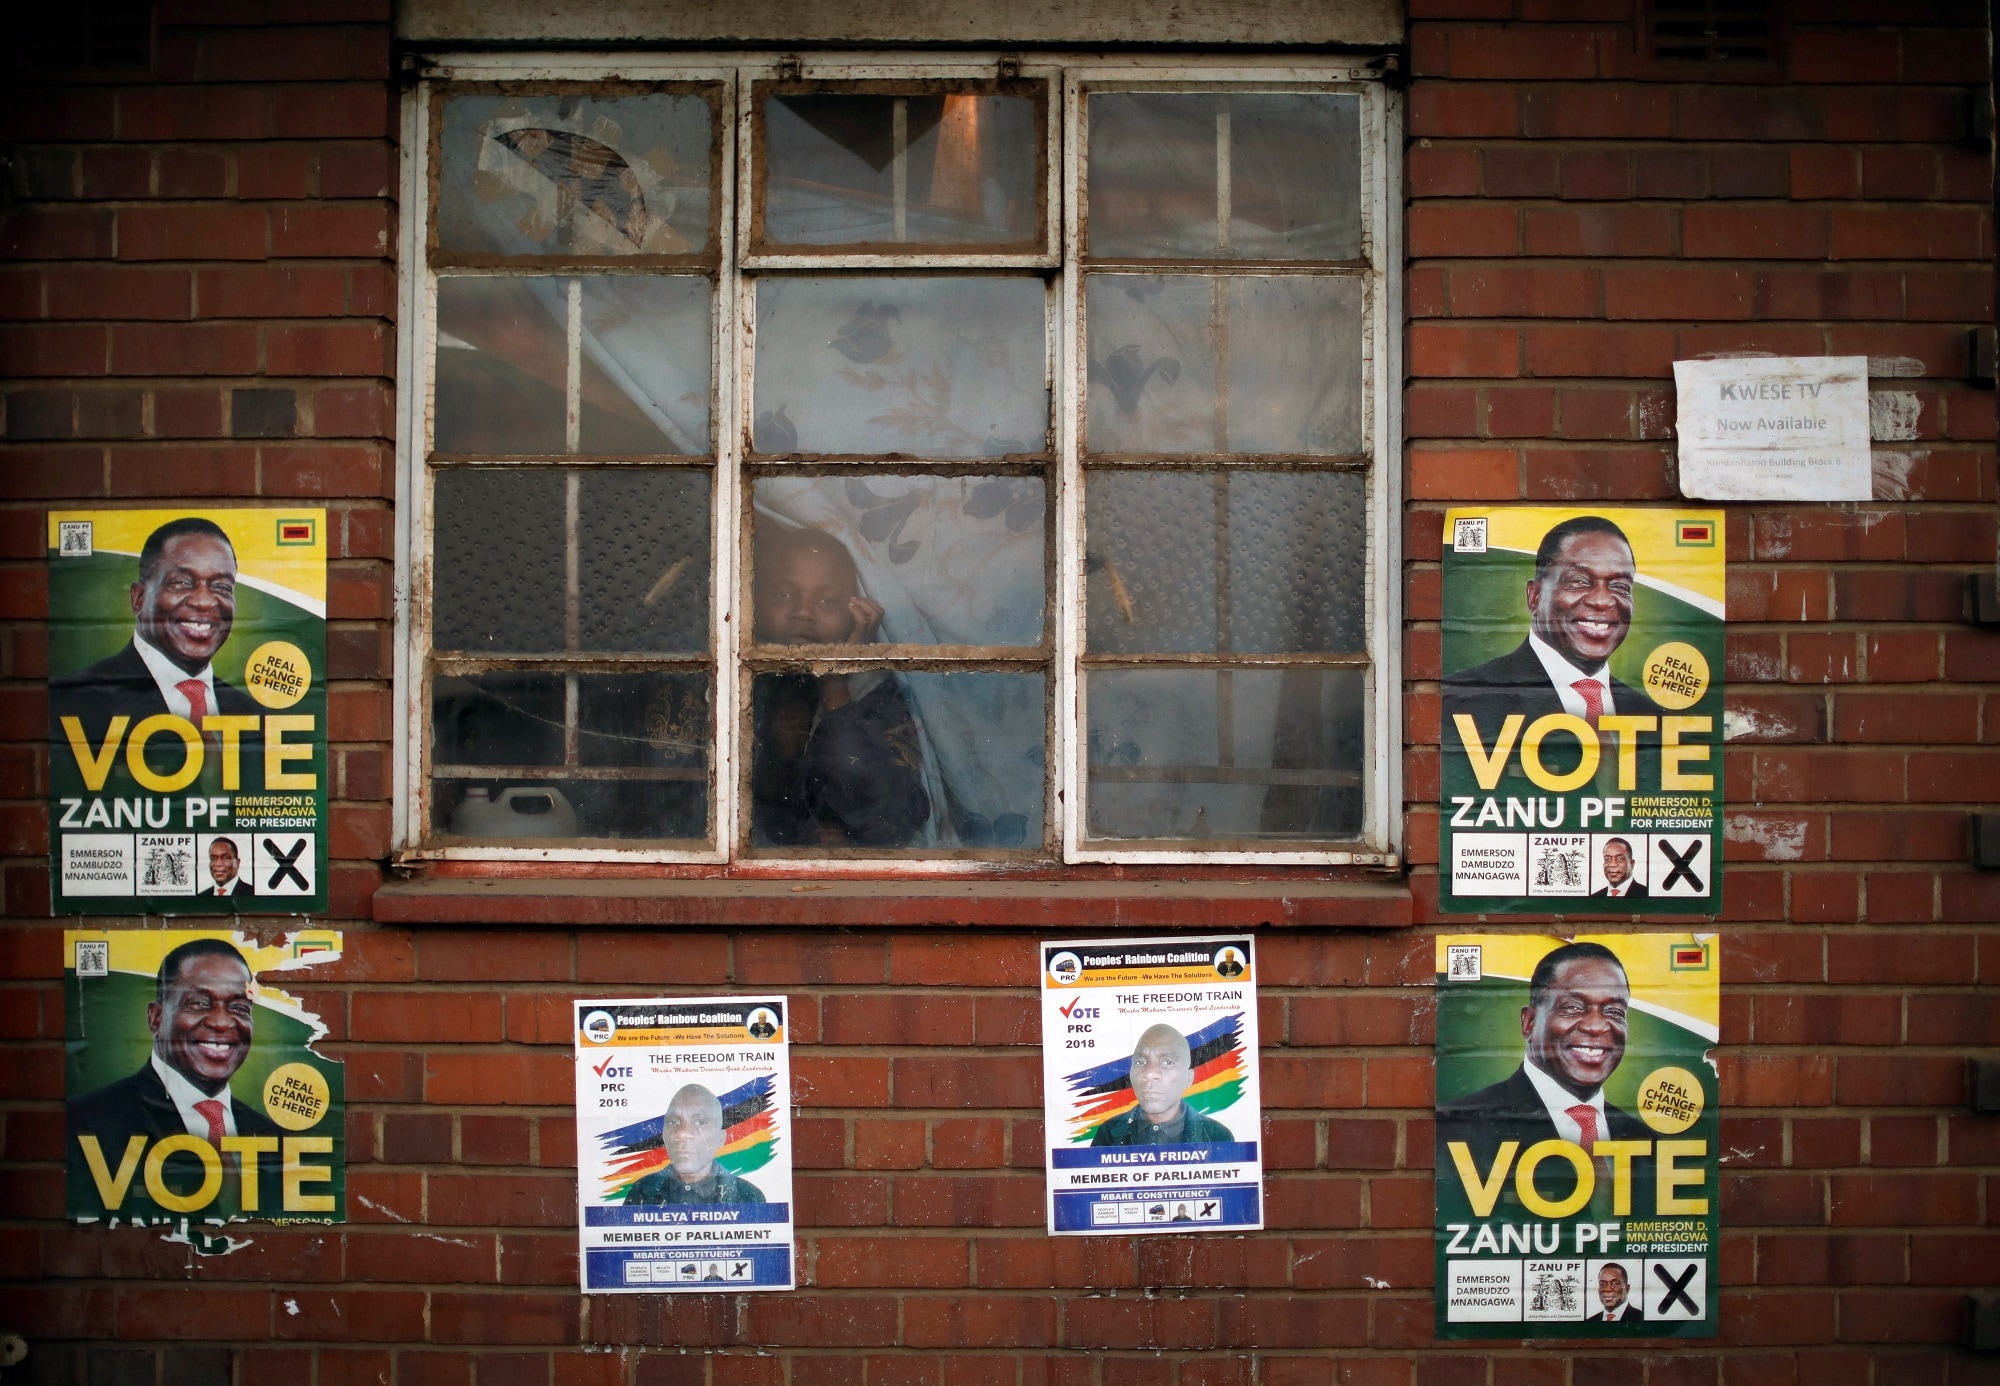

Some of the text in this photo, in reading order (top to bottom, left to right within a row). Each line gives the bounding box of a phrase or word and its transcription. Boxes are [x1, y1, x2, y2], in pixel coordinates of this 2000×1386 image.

[1720, 382, 1823, 401] KWESE TV
[1717, 416, 1827, 431] Now Available
[267, 655, 296, 675] REAL
[1665, 656, 1694, 675] REAL
[253, 663, 304, 687] CHANGE
[1651, 664, 1702, 689] CHANGE
[250, 673, 298, 697] IS HERE!
[1648, 674, 1696, 698] IS HERE!
[60, 714, 317, 792] VOTE
[1452, 713, 1714, 792] VOTE
[235, 797, 317, 806] EMMERSON D.
[1631, 797, 1713, 807] EMMERSON D.
[59, 797, 229, 828] ZANU PF
[235, 807, 317, 817] MNANGAGWA
[1451, 796, 1625, 828] ZANU PF
[1631, 807, 1713, 817] MNANGAGWA
[235, 818, 317, 828] FOR PRESIDENT
[1631, 818, 1713, 828] FOR PRESIDENT
[141, 837, 191, 846] ZANU PF
[1534, 837, 1585, 846] ZANU PF
[70, 849, 123, 858] EMMERSON
[1461, 848, 1515, 857] EMMERSON
[70, 861, 122, 869] DAMBUDZO
[1461, 860, 1515, 869] DAMBUDZO
[65, 872, 128, 881] MNANGAGWA
[1455, 871, 1520, 880] MNANGAGWA
[1125, 953, 1165, 964] Rainbow
[1167, 952, 1210, 963] Coalition
[1116, 991, 1242, 1004] THE FREEDOM TRAIN
[658, 1014, 698, 1024] Rainbow
[700, 1013, 742, 1023] Coalition
[1067, 1024, 1092, 1033] PRC
[1065, 1039, 1095, 1049] 2018
[649, 1052, 775, 1064] THE FREEDOM TRAIN
[285, 1077, 314, 1096] REAL
[601, 1083, 625, 1092] PRC
[1659, 1081, 1688, 1099] REAL
[272, 1085, 322, 1110] CHANGE
[599, 1098, 628, 1107] 2018
[1645, 1088, 1696, 1112] CHANGE
[268, 1095, 317, 1119] IS HERE!
[1642, 1099, 1690, 1122] IS HERE!
[1101, 1150, 1208, 1164] MULEYA FRIDAY
[77, 1134, 336, 1213] VOTE
[1070, 1169, 1240, 1184] MEMBER OF PARLIAMENT
[1447, 1139, 1709, 1218] VOTE
[1101, 1190, 1211, 1201] MBARE CONSTITUENCY
[633, 1211, 740, 1223] MULEYA FRIDAY
[1626, 1222, 1708, 1231] EMMERSON D.
[603, 1230, 772, 1242] MEMBER OF PARLIAMENT
[1446, 1223, 1620, 1254] ZANU PF
[1626, 1232, 1708, 1242] MNANGAGWA
[1626, 1243, 1708, 1253] FOR PRESIDENT
[633, 1250, 743, 1259] MBARE CONSTITUENCY
[1529, 1263, 1580, 1272] ZANU PF
[1456, 1275, 1510, 1284] EMMERSON
[1457, 1286, 1510, 1295] DAMBUDZO
[1451, 1298, 1515, 1307] MNANGAGWA
